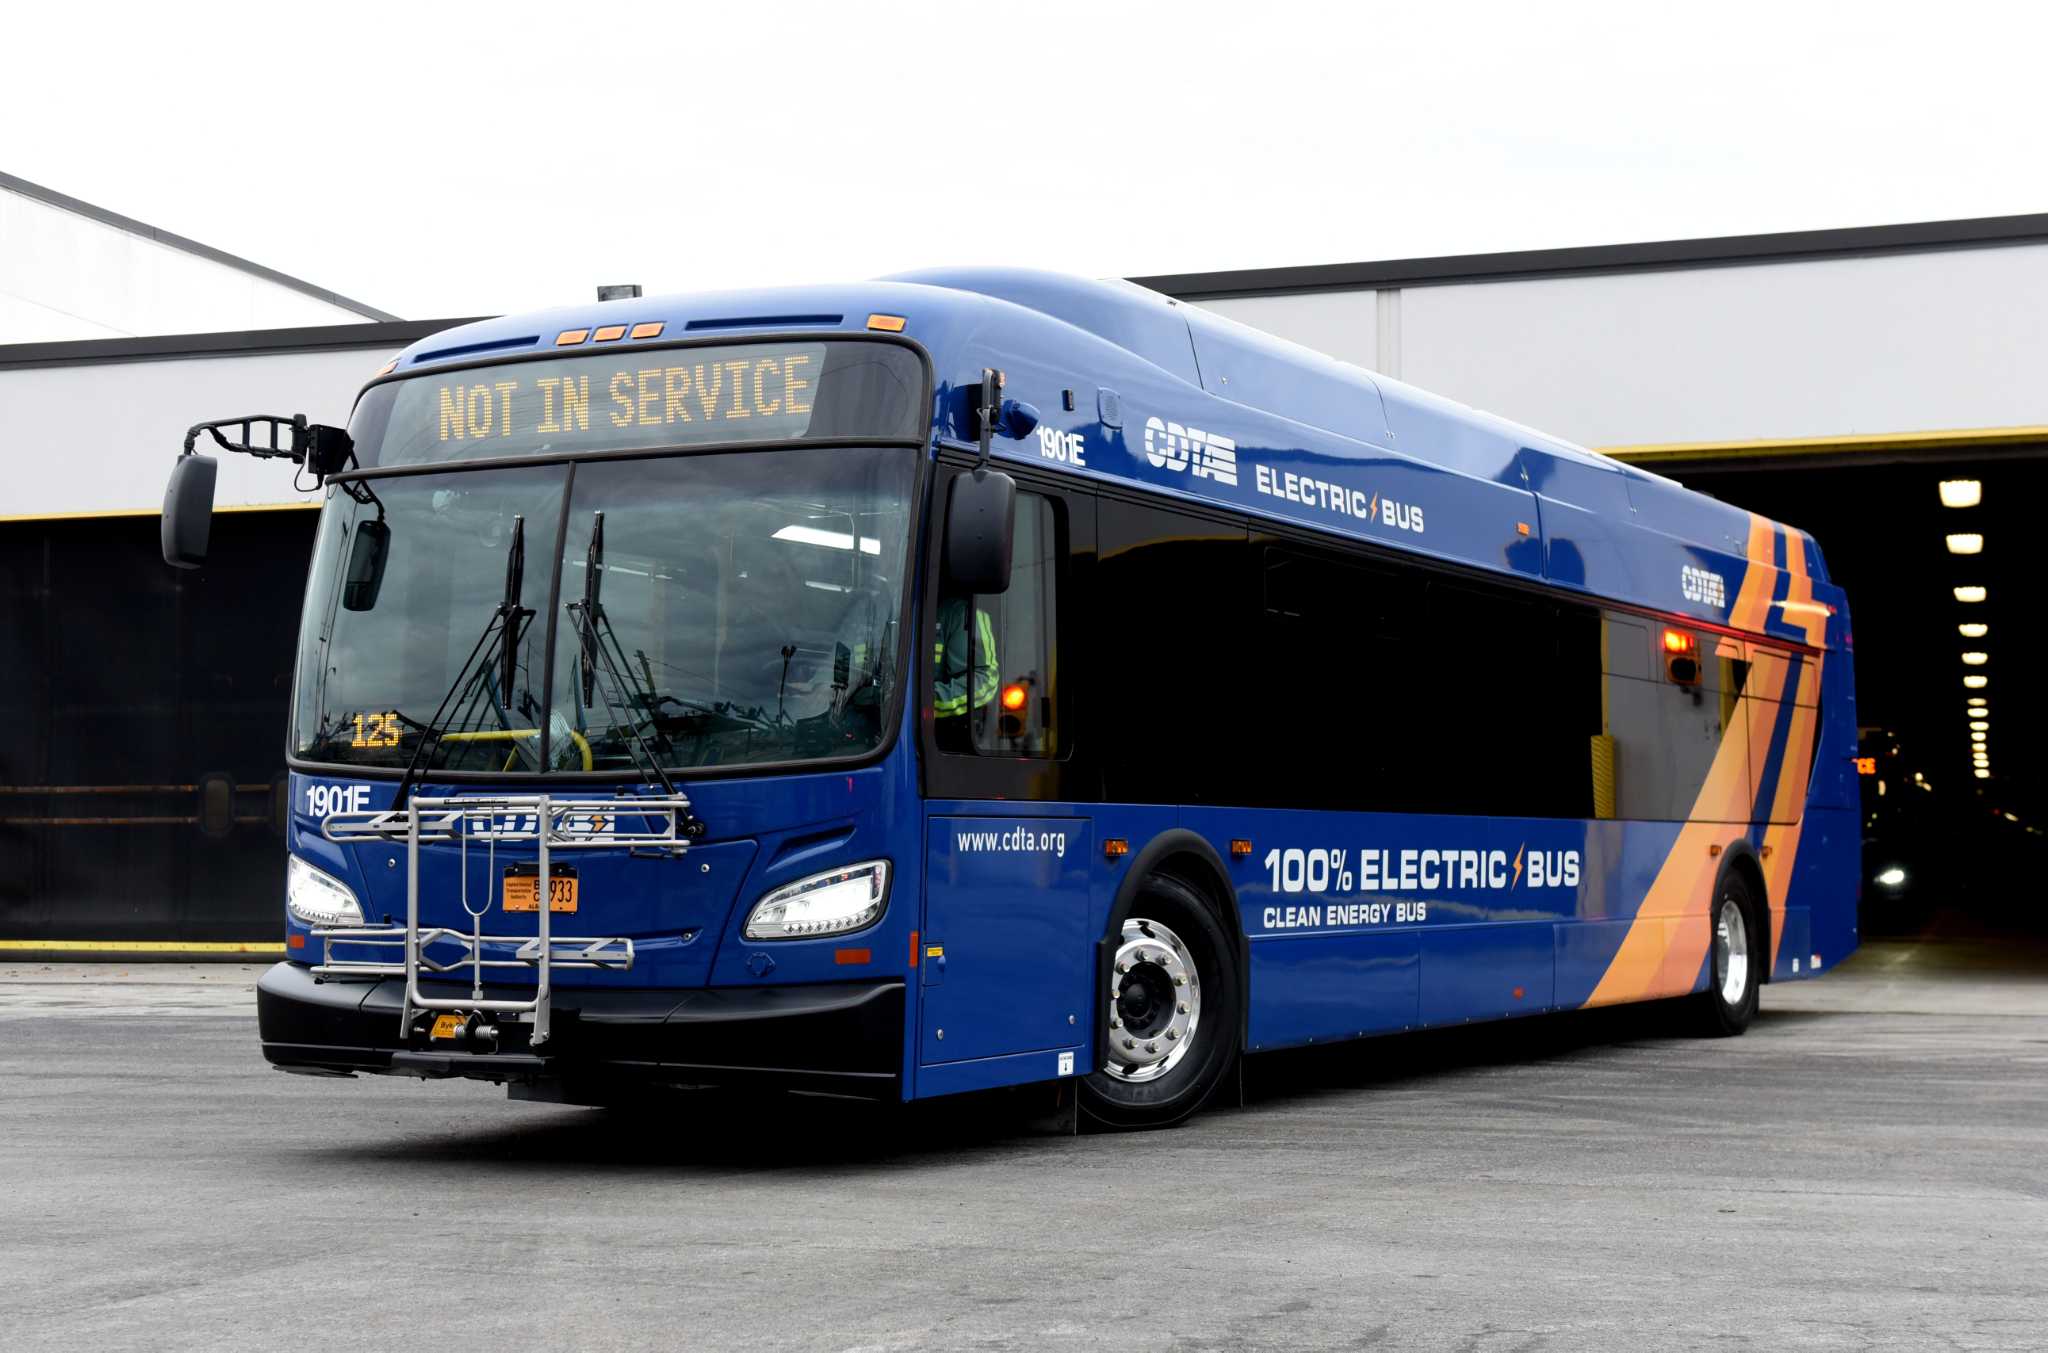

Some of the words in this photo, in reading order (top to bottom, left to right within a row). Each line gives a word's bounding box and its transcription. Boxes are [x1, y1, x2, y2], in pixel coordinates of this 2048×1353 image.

[440, 382, 518, 441] NOT
[538, 375, 589, 433] IN
[608, 355, 811, 428] SERVICE
[1036, 425, 1086, 467] 1901E
[1144, 416, 1238, 487] CDTA
[1255, 464, 1368, 520] ELECTRIC
[1381, 499, 1424, 534] BUS
[1681, 565, 1725, 608] CDTA
[351, 713, 399, 747] 125
[957, 826, 1065, 858] www.cdta.org
[1263, 848, 1353, 893] 100%
[1360, 849, 1507, 891] ELECTRIC
[1527, 850, 1580, 888] BUS
[1263, 906, 1321, 929] CLEAN
[1326, 903, 1391, 926] ENERGY
[1396, 902, 1426, 922] BUS
